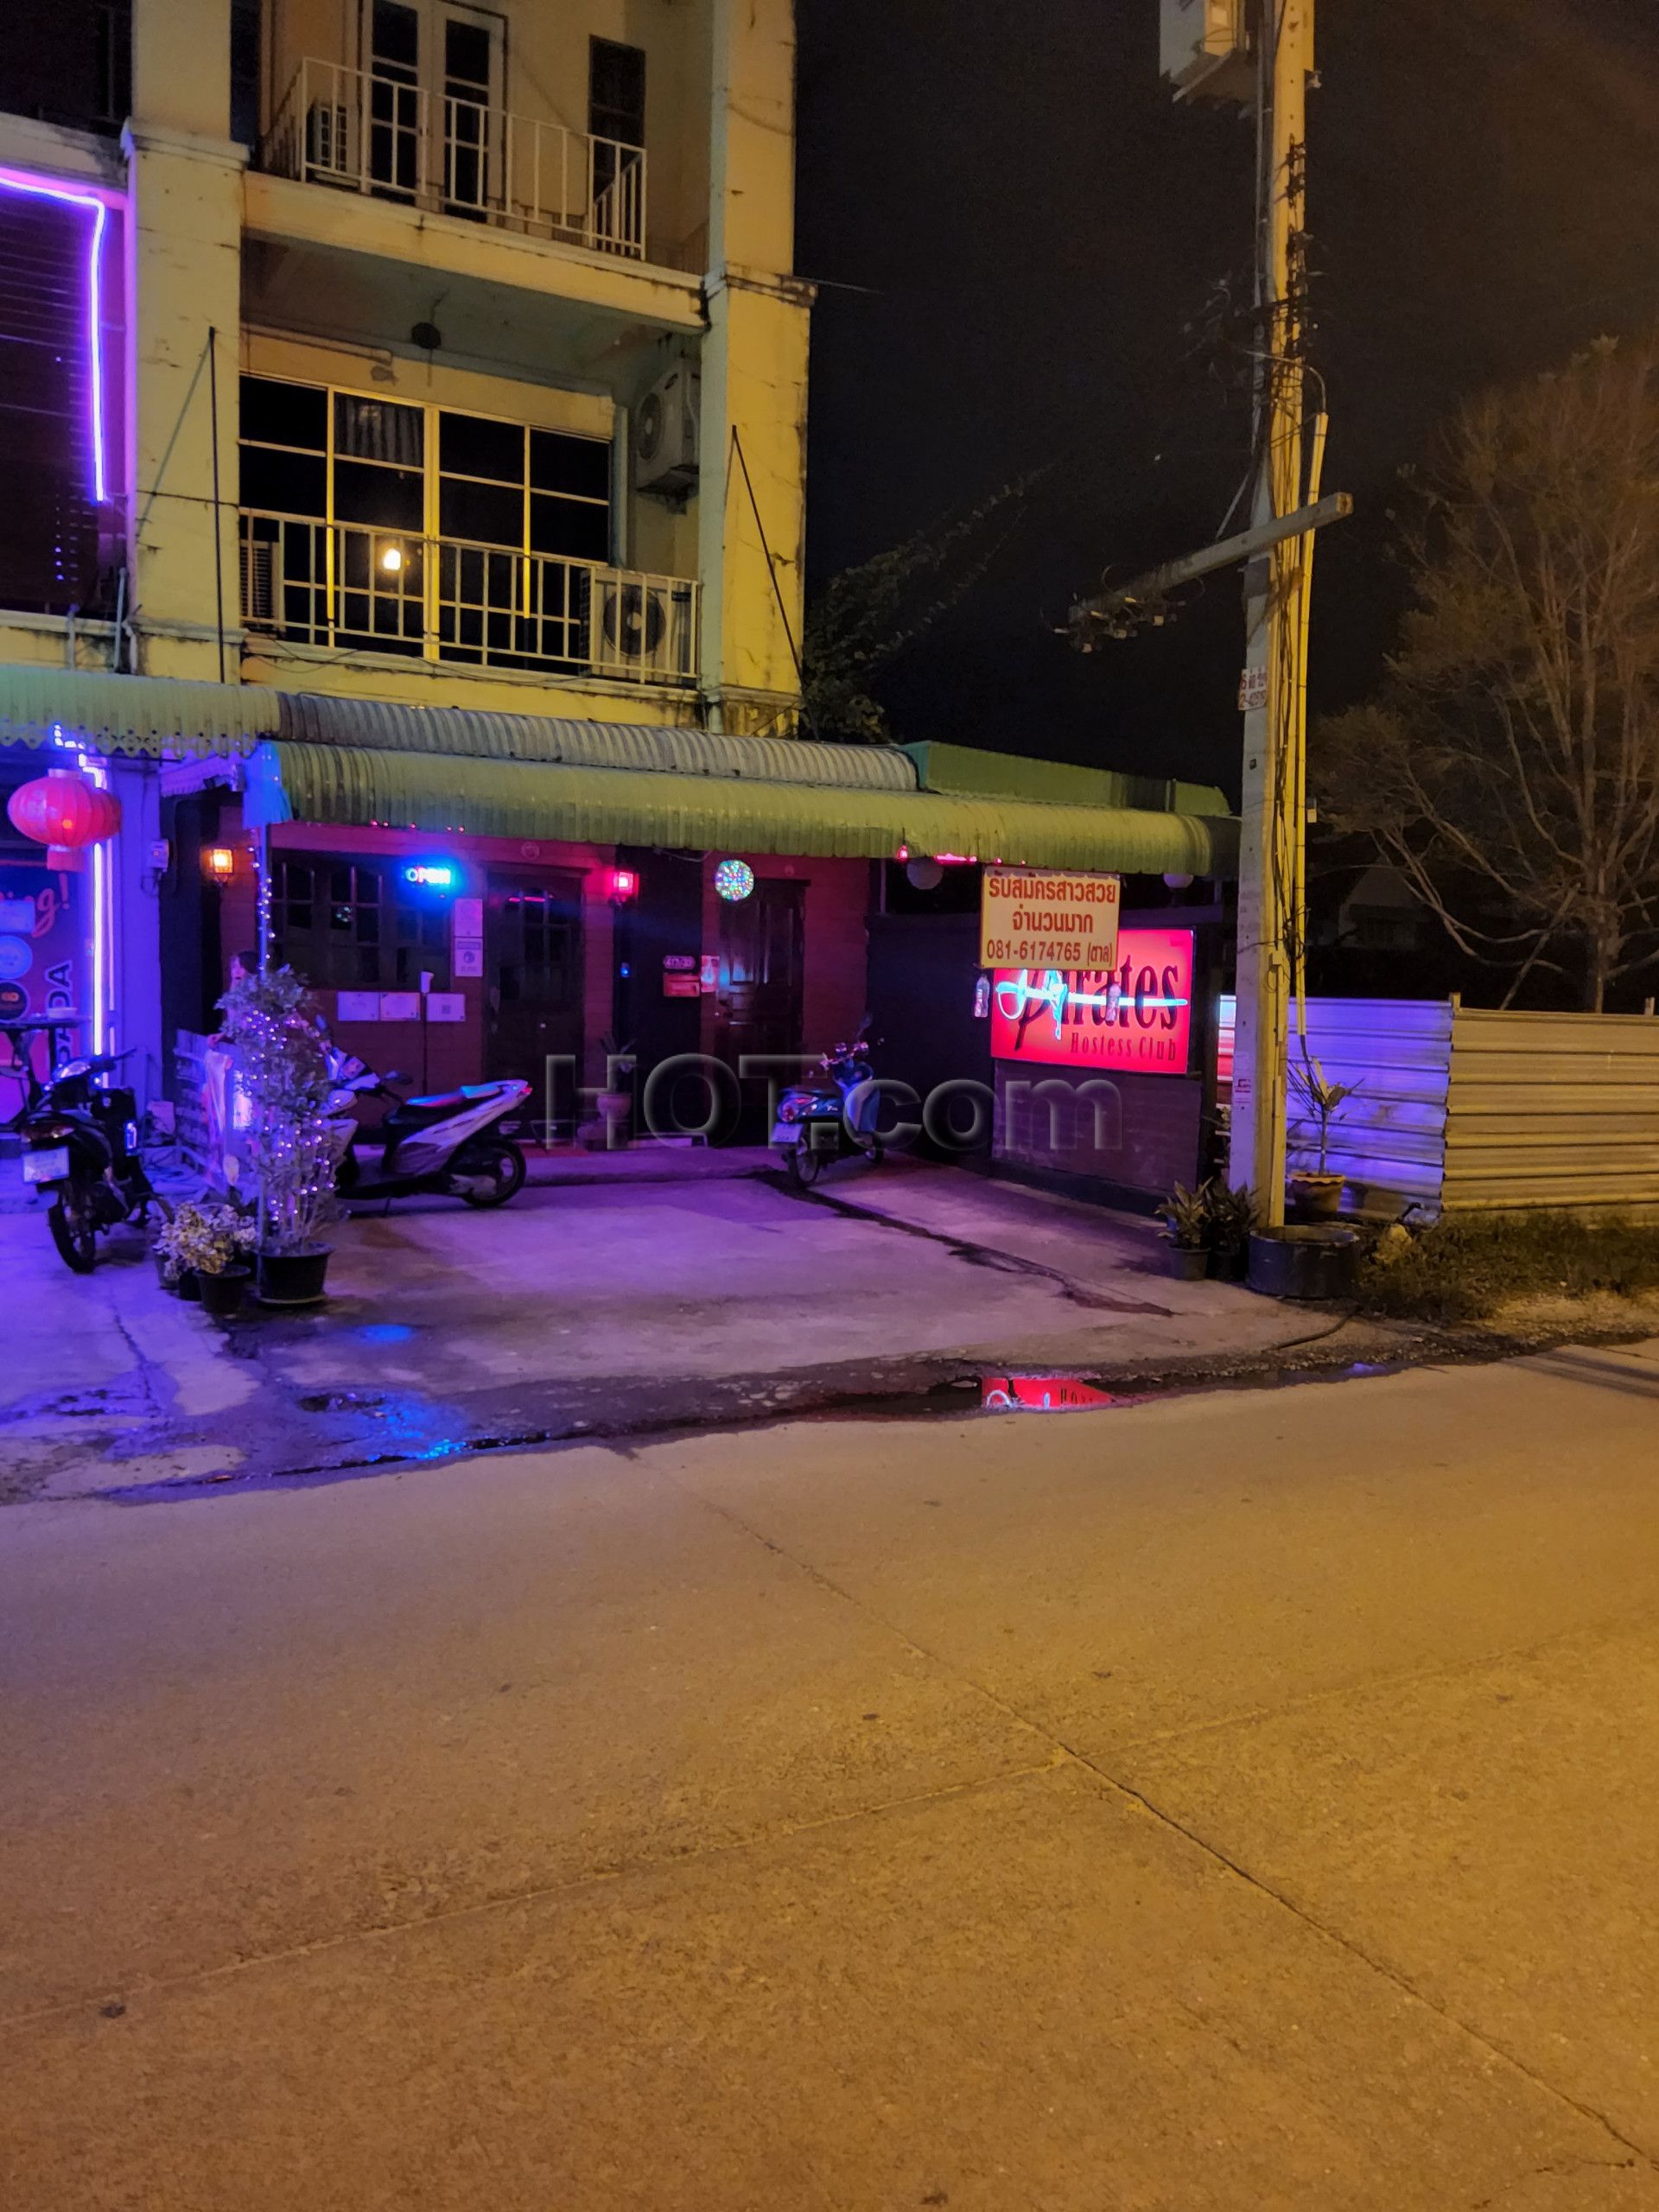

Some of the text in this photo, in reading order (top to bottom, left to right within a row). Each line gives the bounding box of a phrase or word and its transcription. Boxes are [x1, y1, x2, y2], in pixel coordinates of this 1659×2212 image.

[405, 866, 451, 884] OP
[988, 870, 1116, 904] รับสมัครสาวสวย
[1012, 904, 1094, 934] จำนวนมาก
[987, 939, 1081, 962] 081-6174765
[1071, 1032, 1176, 1062] Hostess Club
